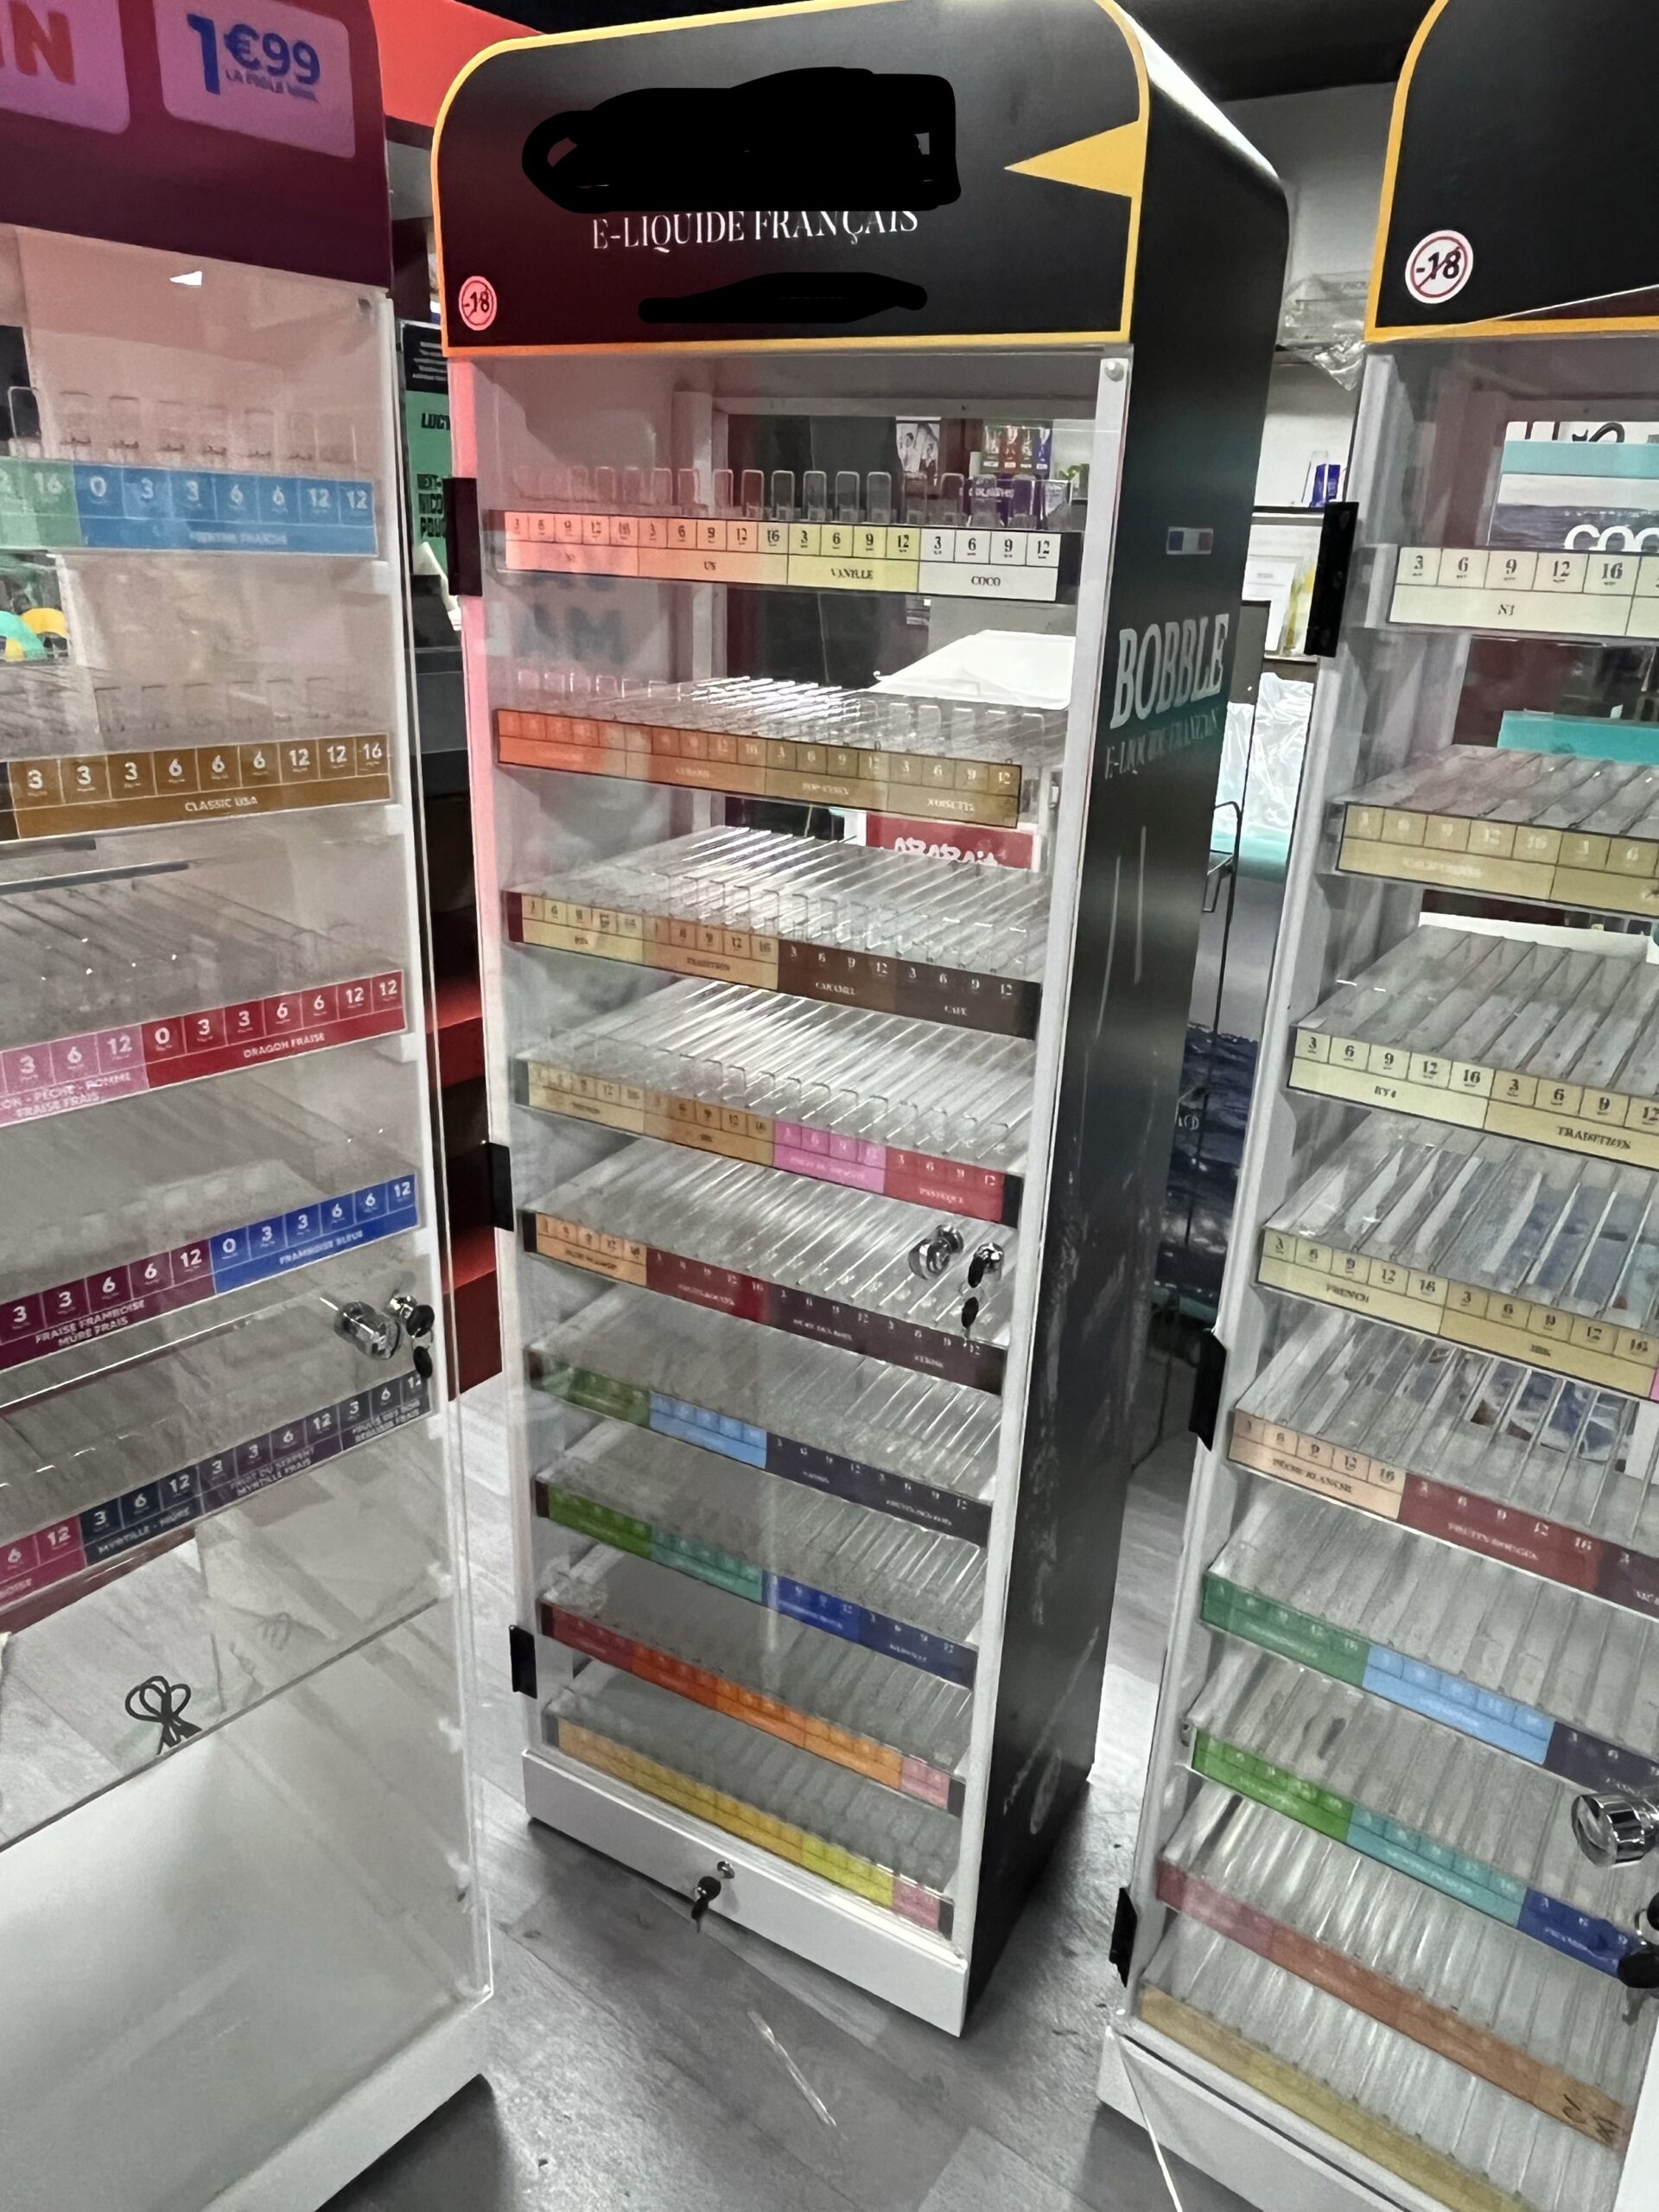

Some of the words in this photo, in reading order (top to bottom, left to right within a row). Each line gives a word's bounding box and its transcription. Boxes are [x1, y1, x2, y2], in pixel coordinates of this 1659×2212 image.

[0, 0, 76, 86] N
[186, 12, 321, 95] 1€99
[593, 211, 745, 253] E-LIQUIDE
[755, 209, 918, 244] FRANÇAIS
[1416, 250, 1461, 280] -18
[462, 291, 490, 315] -18
[35, 473, 63, 495] 16
[91, 476, 106, 498] 0
[142, 478, 154, 499] 3
[187, 480, 199, 501] 3
[231, 483, 243, 505] 6
[273, 486, 284, 505] 6
[308, 488, 330, 508] 12
[348, 490, 368, 509] 12
[800, 530, 808, 543] 3
[833, 532, 840, 544] 6
[866, 534, 873, 546] 9
[898, 535, 909, 548] 12
[934, 537, 941, 549] 3
[968, 538, 976, 550] 6
[1004, 539, 1012, 552] 9
[1038, 540, 1049, 554] 12
[971, 576, 1001, 586] COCO
[1414, 556, 1423, 569] 3
[1459, 557, 1468, 571] 6
[1506, 559, 1516, 574] 9
[1553, 561, 1569, 576] 12
[1602, 563, 1622, 580] 16
[1109, 613, 1230, 729] BOBBLE
[29, 770, 42, 789] 3
[77, 766, 91, 785] 3
[124, 762, 138, 781] 3
[169, 759, 182, 777] 6
[212, 755, 225, 773] 6
[253, 752, 265, 769] 6
[289, 748, 310, 766] 12
[327, 746, 346, 763] 12
[362, 742, 381, 760] 16
[185, 798, 232, 813] CLASSIC
[156, 1027, 170, 1045] 0
[198, 1019, 211, 1036] 3
[238, 1011, 251, 1027] 3
[276, 1002, 288, 1020] 6
[314, 995, 325, 1011] 6
[346, 987, 365, 1004] 12
[379, 979, 397, 996] 12
[21, 1055, 35, 1074] 3
[67, 1046, 82, 1064] 6
[107, 1036, 132, 1055] 12
[1308, 1038, 1316, 1050] 3
[1345, 1046, 1354, 1057] 6
[1385, 1053, 1394, 1065] 9
[1423, 1061, 1437, 1074] 12
[1554, 1089, 1563, 1101] 6
[1599, 1097, 1609, 1109] 9
[223, 1237, 236, 1255] 0
[262, 1226, 273, 1242] 3
[298, 1215, 308, 1230] 3
[332, 1204, 342, 1217] 6
[365, 1192, 375, 1207] 6
[394, 1182, 411, 1197] 12
[14, 1306, 27, 1322] 3
[59, 1291, 72, 1307] 3
[103, 1276, 115, 1293] 6
[144, 1262, 157, 1278] 6
[181, 1249, 202, 1267] 12
[35, 1324, 77, 1344] FRAISE
[349, 1402, 359, 1414] 3
[381, 1387, 391, 1402] 6
[213, 1460, 223, 1474] 3
[249, 1446, 259, 1459] 3
[283, 1429, 293, 1444] 6
[314, 1414, 331, 1432] 12
[94, 1511, 106, 1526] 3
[135, 1493, 147, 1508] 6
[169, 1475, 189, 1493] 12
[8, 1548, 21, 1563] 6
[48, 1528, 70, 1546] 12
